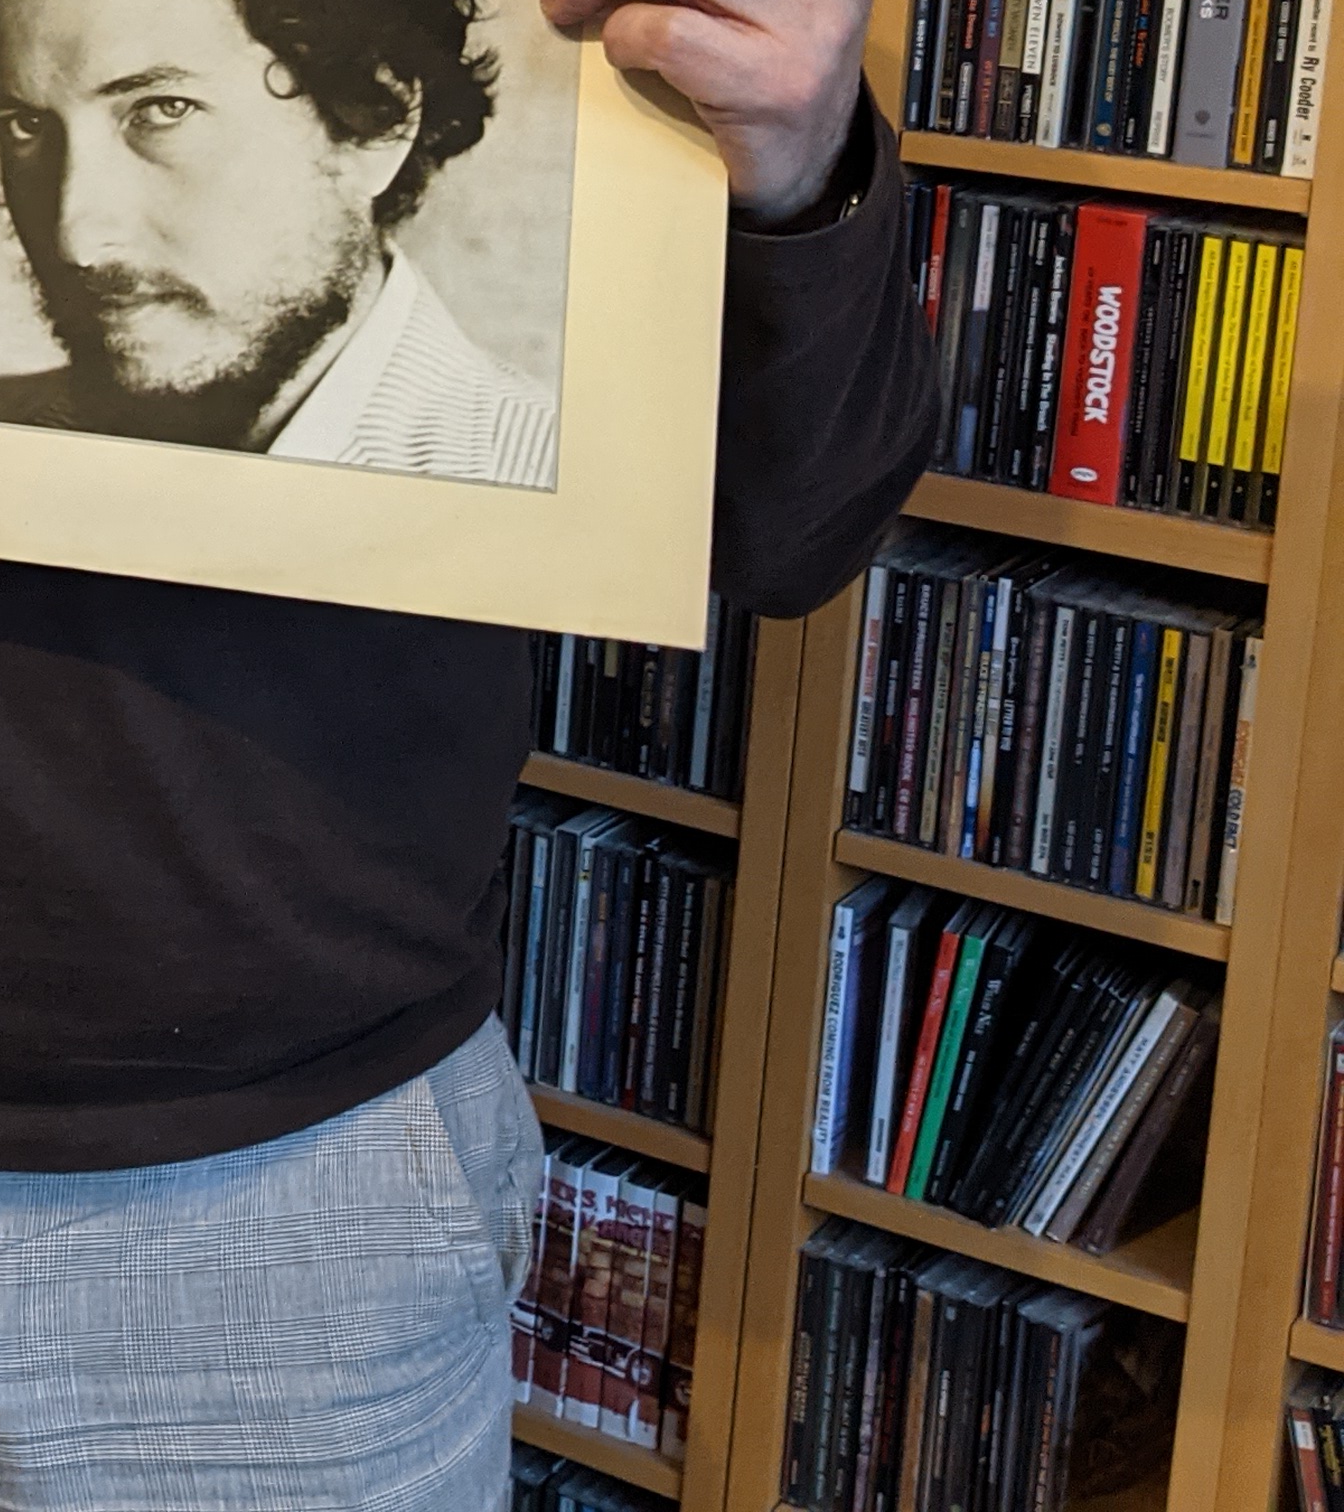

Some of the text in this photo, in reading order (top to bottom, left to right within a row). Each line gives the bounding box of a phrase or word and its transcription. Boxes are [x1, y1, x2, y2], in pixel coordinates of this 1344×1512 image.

[1026, 26, 1043, 70] ELEVEN
[1157, 53, 1172, 83] STORY
[1300, 56, 1321, 73] Ry
[1295, 77, 1316, 120] Cooder
[1040, 254, 1066, 399] Jackson Browne Standing The
[1083, 285, 1122, 425] WOODSTOCK
[910, 584, 931, 690] BRUCE SPRINGSTEEN
[1003, 699, 1014, 725] LETTER
[1227, 789, 1242, 821] COLD
[817, 949, 845, 1145] RODRIGUEZ COMING FROM REALITY
